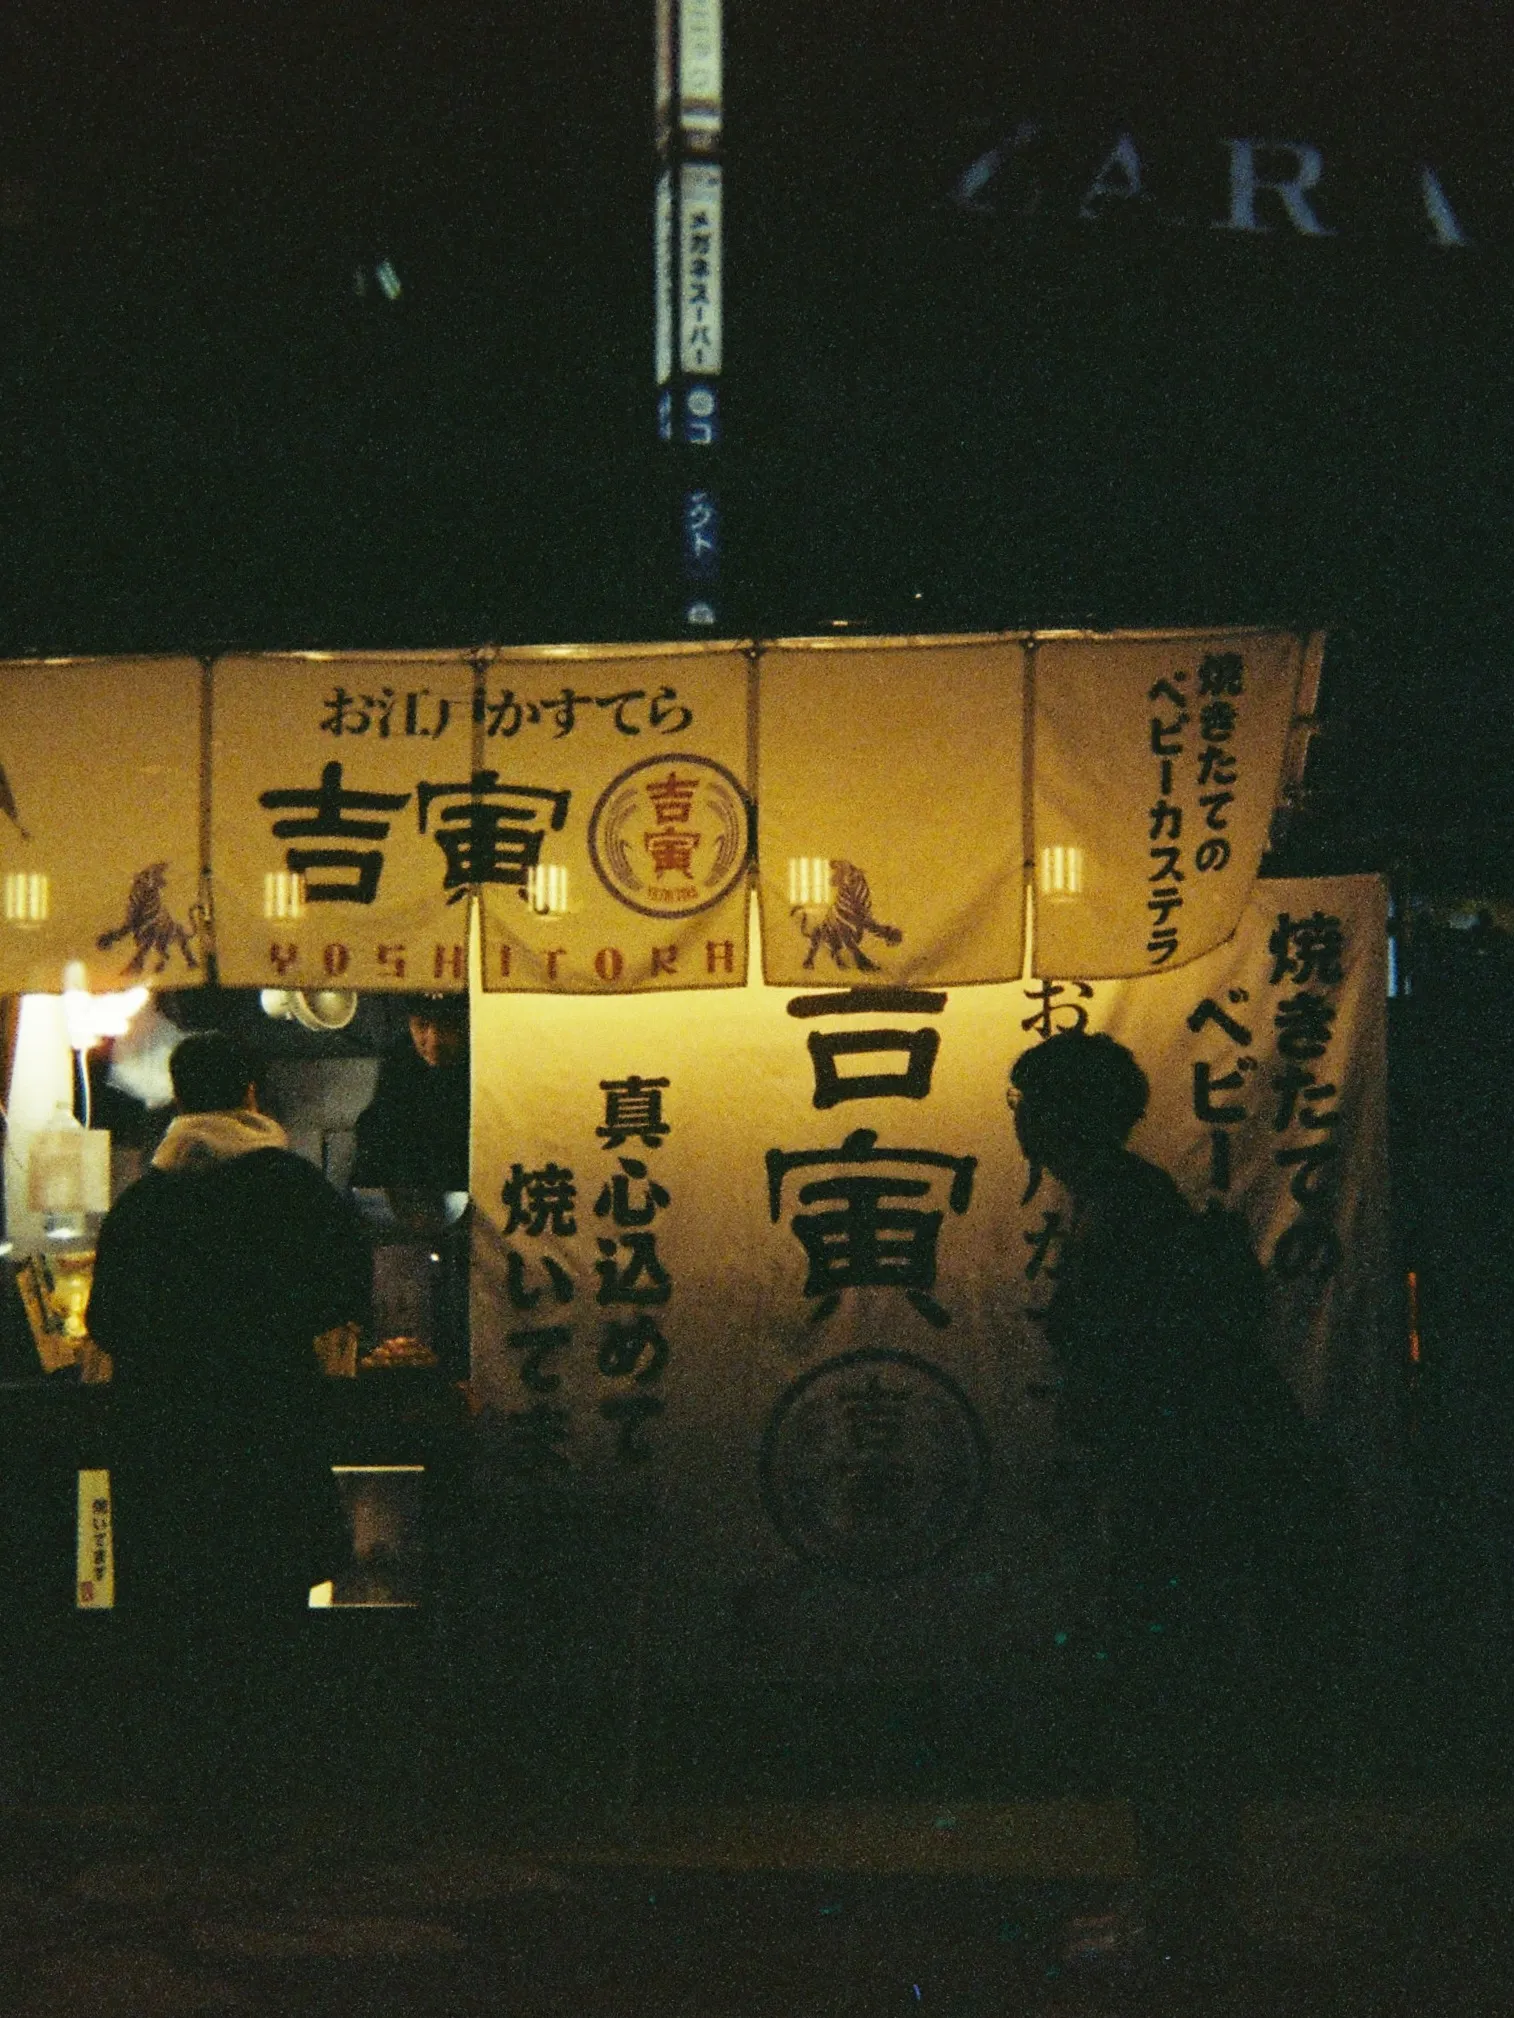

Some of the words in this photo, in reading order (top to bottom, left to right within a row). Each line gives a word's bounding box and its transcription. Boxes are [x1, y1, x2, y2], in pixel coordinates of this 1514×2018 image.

[1147, 670, 1189, 965] ベビーカステラ
[1196, 652, 1244, 872] 焼きたての
[594, 1075, 671, 1463] 真心込めて
